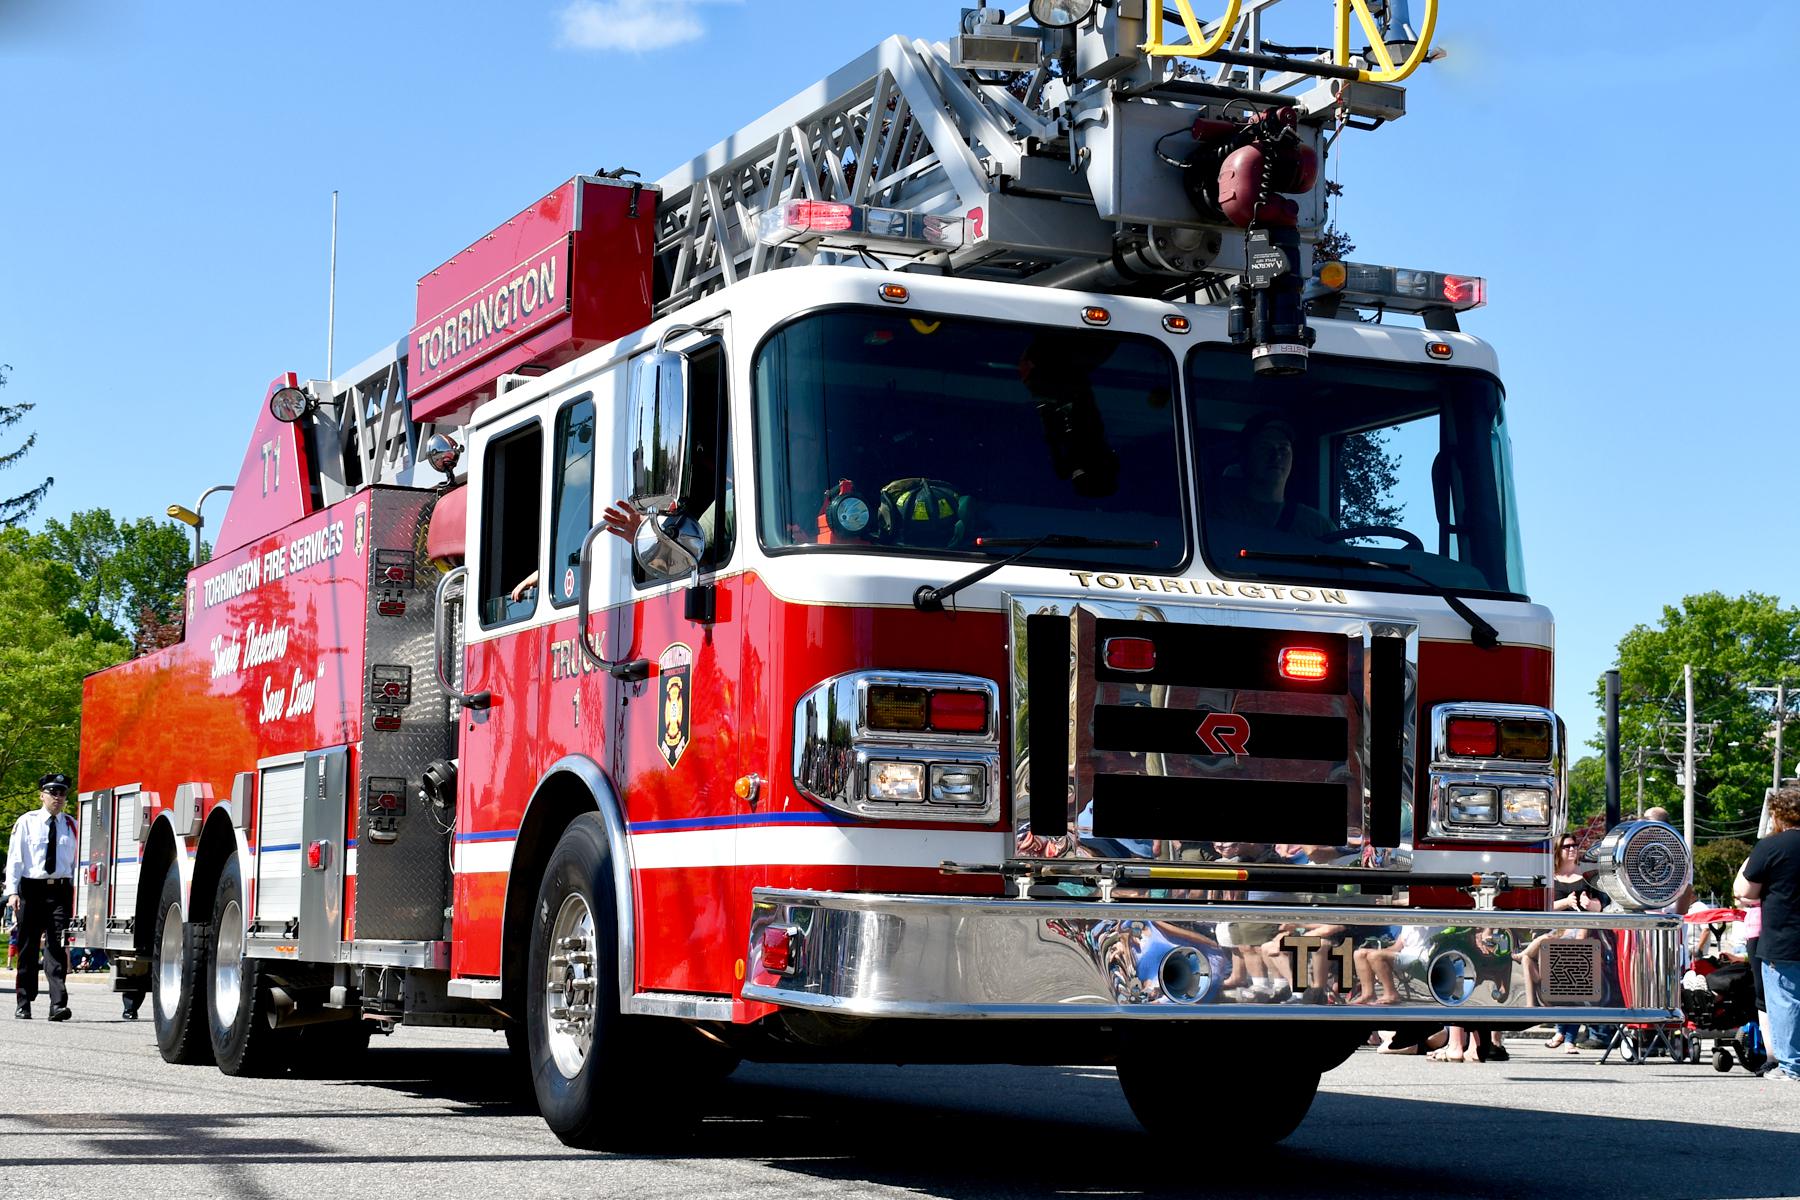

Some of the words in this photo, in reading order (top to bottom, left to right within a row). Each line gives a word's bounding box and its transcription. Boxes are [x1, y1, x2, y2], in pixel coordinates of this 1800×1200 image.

[1251, 262, 1276, 270] AKRON
[418, 255, 556, 373] TORRINGTON
[262, 434, 281, 497] T1
[203, 557, 261, 609] TORRINGTON
[263, 546, 287, 584] FIRE
[289, 520, 344, 575] SERVICES
[1069, 571, 1348, 604] TORRINGTON
[243, 618, 290, 670] Detectors
[259, 675, 286, 724] Save
[572, 687, 581, 727] 1
[1280, 935, 1353, 993] T1
